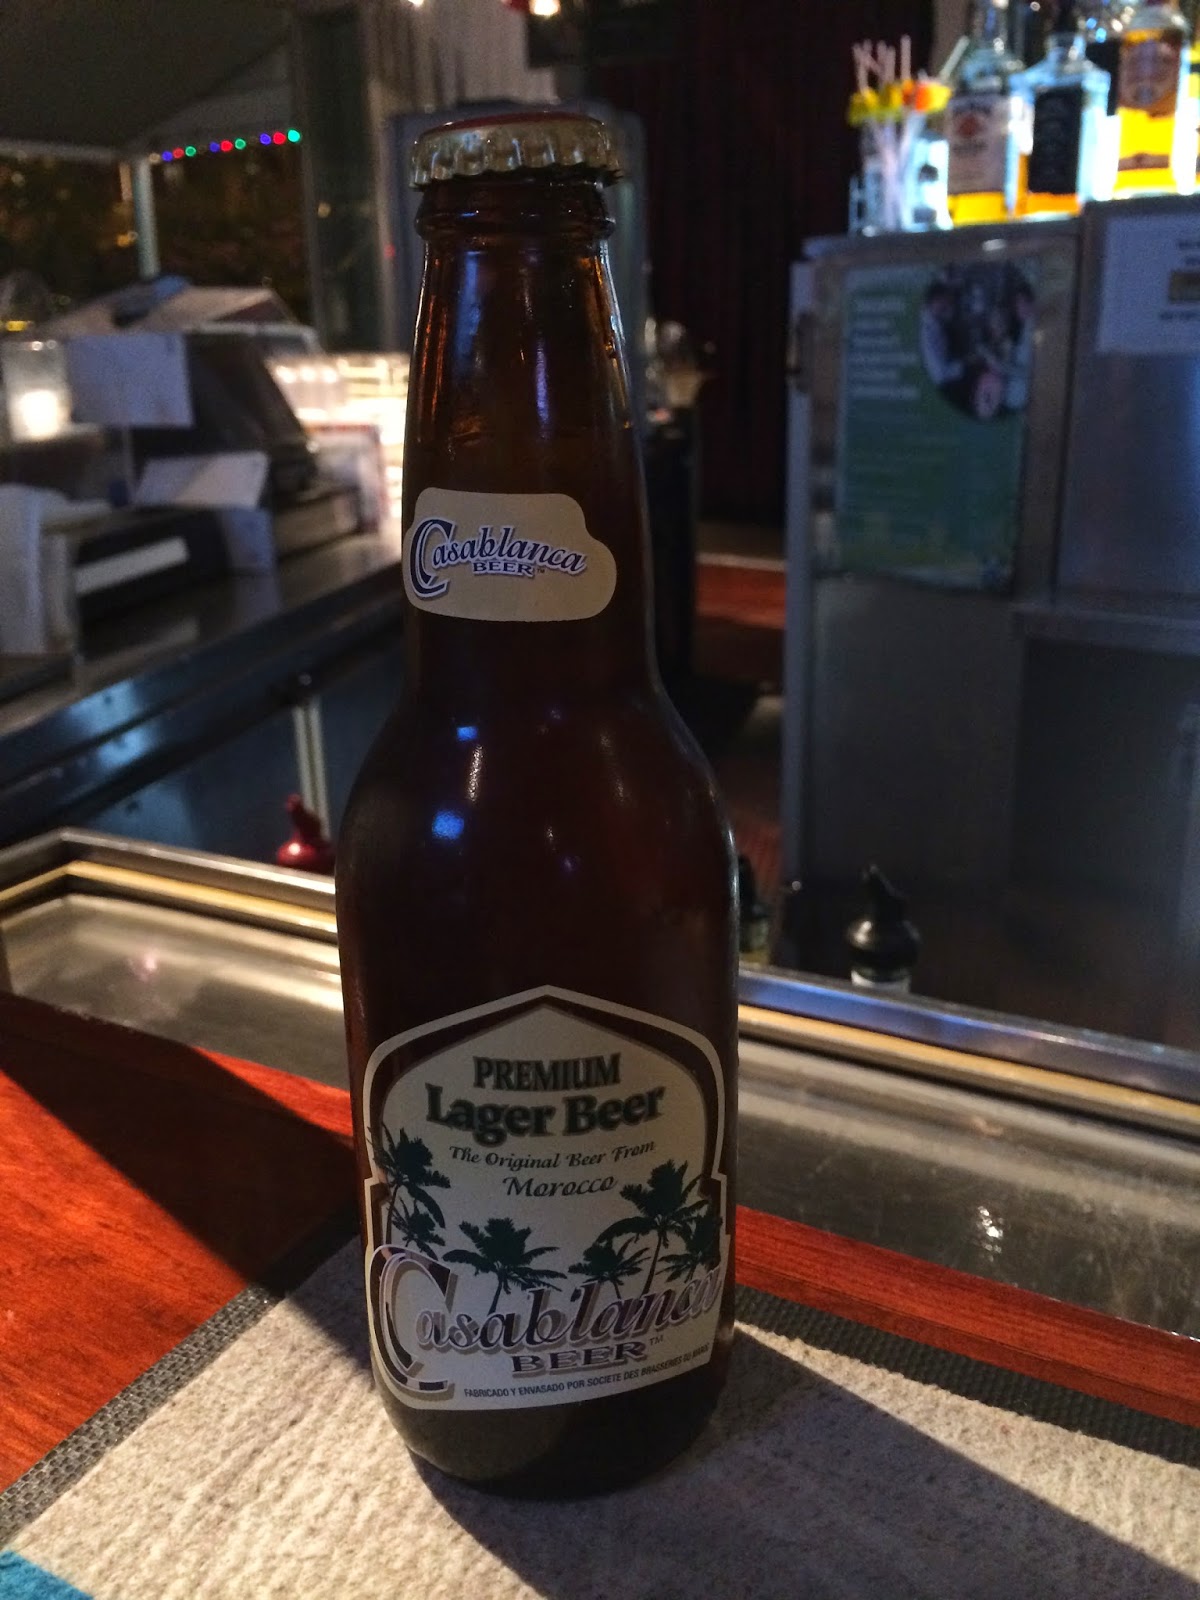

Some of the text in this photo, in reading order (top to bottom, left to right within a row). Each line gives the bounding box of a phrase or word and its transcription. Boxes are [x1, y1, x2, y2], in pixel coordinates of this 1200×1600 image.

[410, 517, 588, 598] Casablanca
[473, 562, 536, 575] BEER
[473, 1053, 621, 1091] PREMIUM
[425, 1083, 666, 1148] Lager Beer
[450, 1139, 655, 1172] The Original Beer From
[502, 1175, 618, 1198] Morocco
[369, 1246, 721, 1391] Casablanca
[511, 1341, 647, 1373] BEER
[464, 1387, 510, 1398] FABRICADO
[510, 1387, 516, 1396] Y
[519, 1381, 565, 1395] ENVASADO
[567, 1379, 585, 1391] POR
[587, 1373, 622, 1388] SOCIETE
[623, 1368, 639, 1381] DES
[641, 1355, 682, 1377] BRASSERIES
